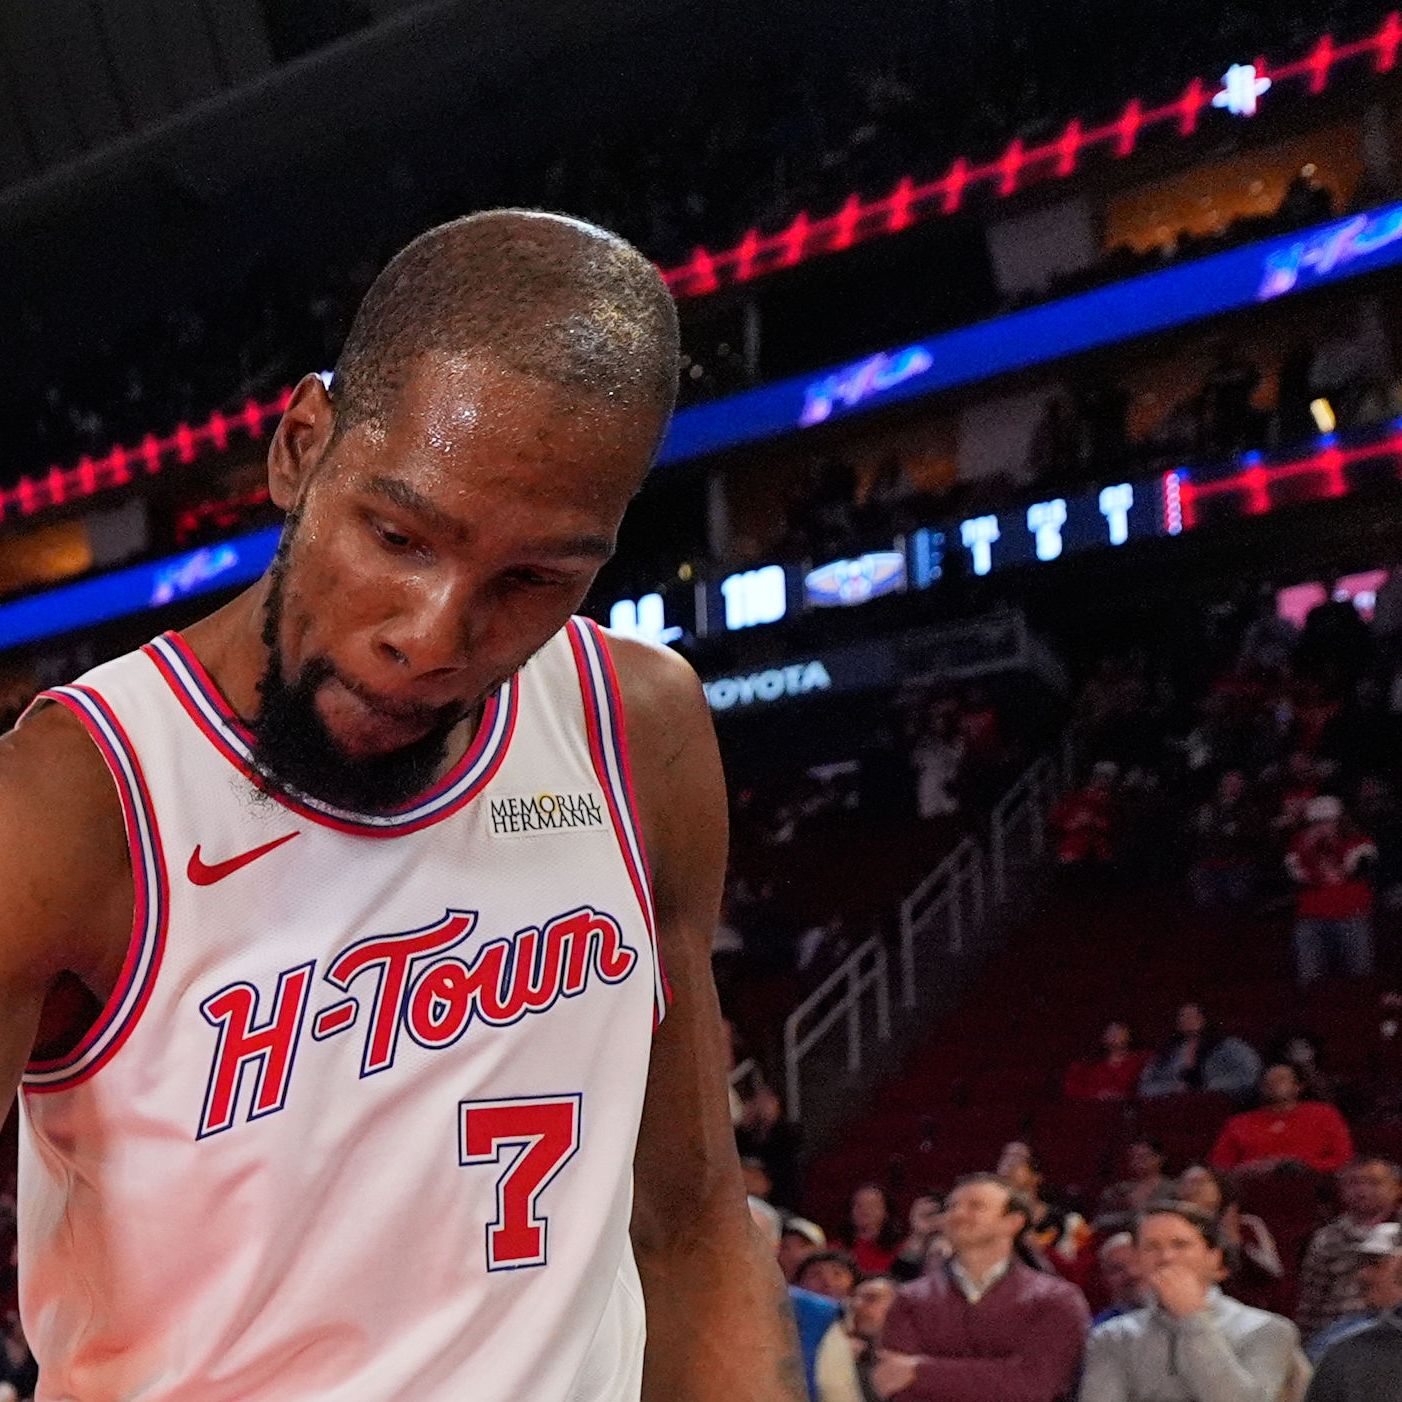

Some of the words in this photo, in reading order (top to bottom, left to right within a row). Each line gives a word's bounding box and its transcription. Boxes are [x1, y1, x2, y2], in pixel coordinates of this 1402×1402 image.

[491, 793, 601, 818] MEMORIAL
[492, 808, 603, 834] HERMANN
[196, 905, 637, 1141] H-Town
[459, 1092, 583, 1272] 7
